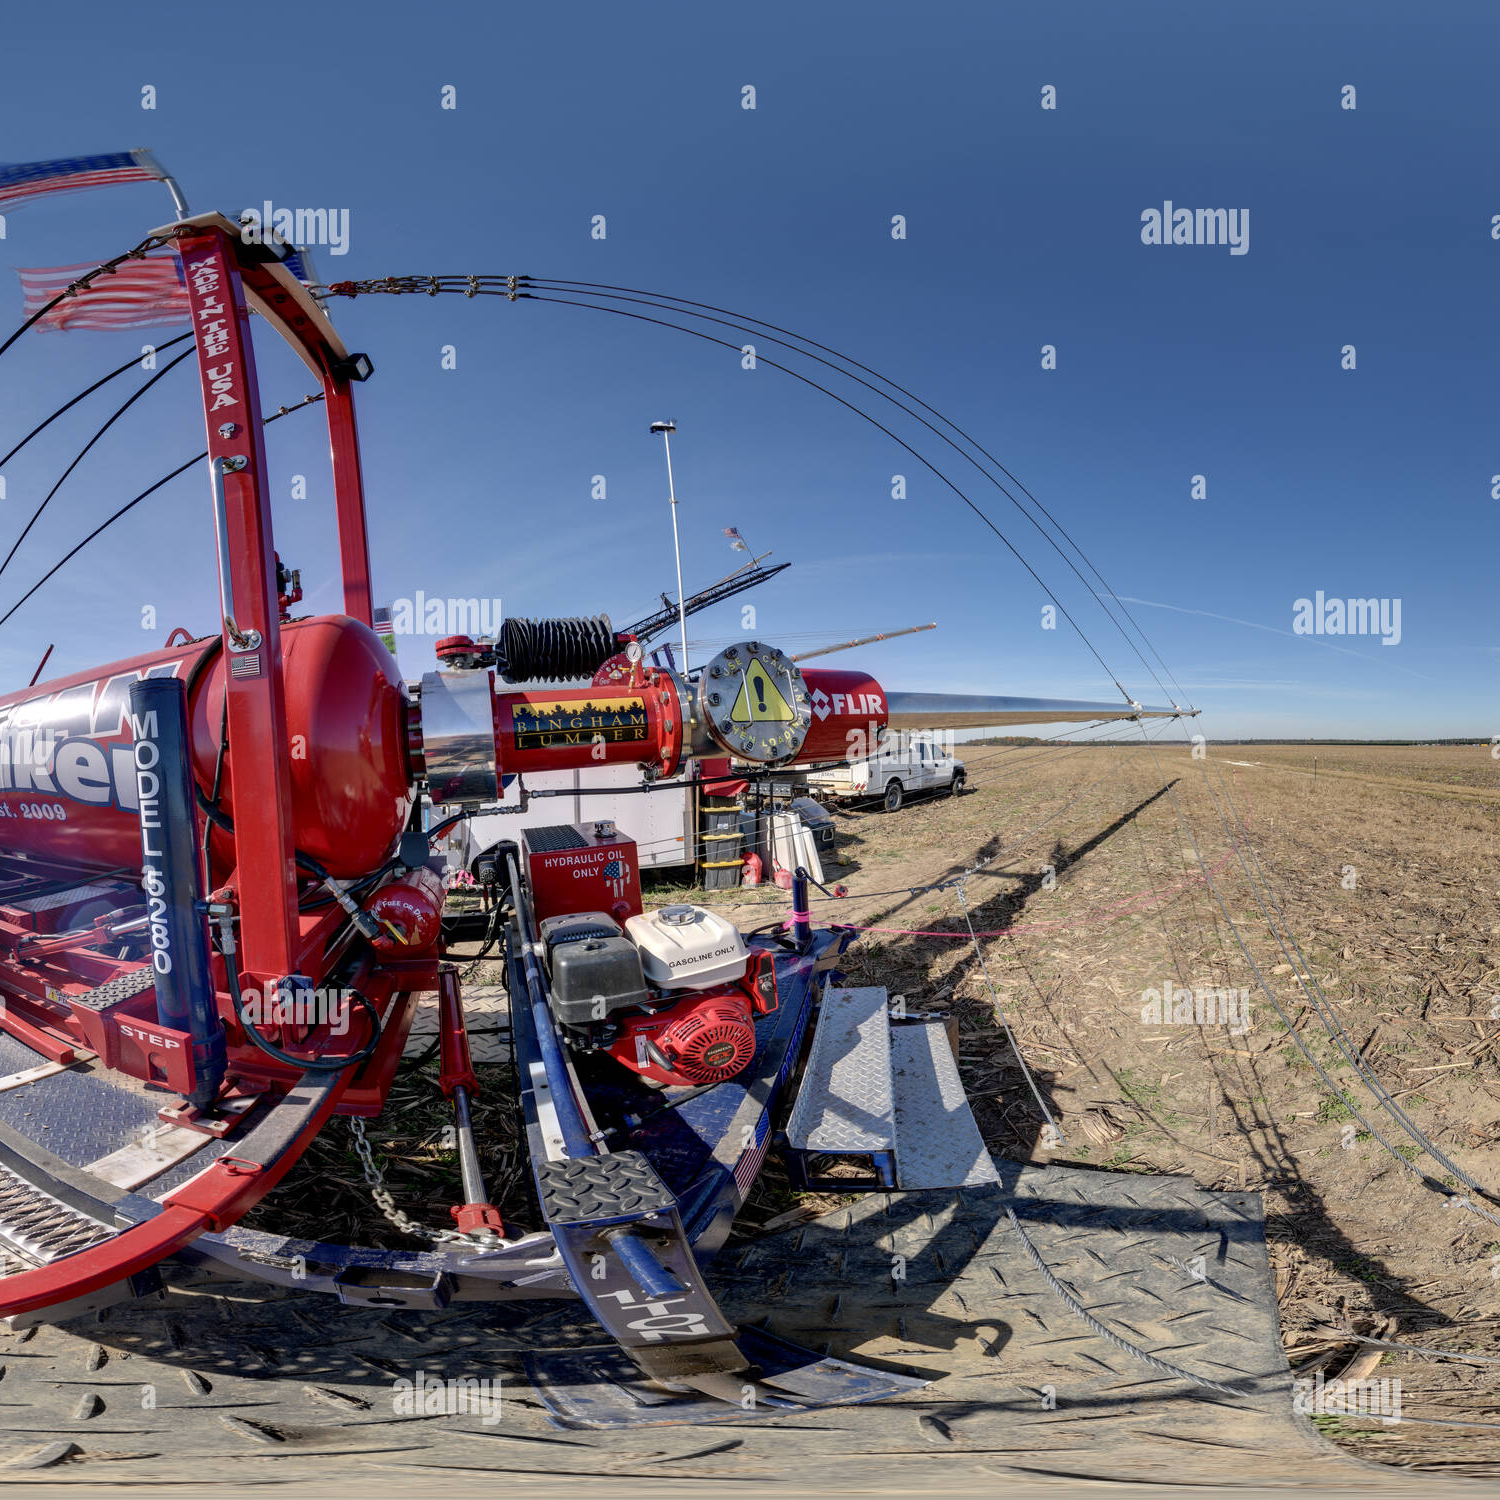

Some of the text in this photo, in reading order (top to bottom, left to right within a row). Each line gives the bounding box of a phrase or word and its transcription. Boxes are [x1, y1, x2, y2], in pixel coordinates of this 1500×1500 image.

[189, 255, 239, 412] MADE IN THE USA
[831, 693, 885, 715] FLIR
[516, 713, 645, 733] BINGHAM
[20, 803, 67, 821] 2009
[131, 710, 173, 974] MODEL 5280
[545, 849, 625, 868] HYDRAULIC OIL
[573, 866, 599, 879] ONLY
[668, 945, 735, 968] GASOLINE ONLY
[119, 1024, 181, 1049] STEP
